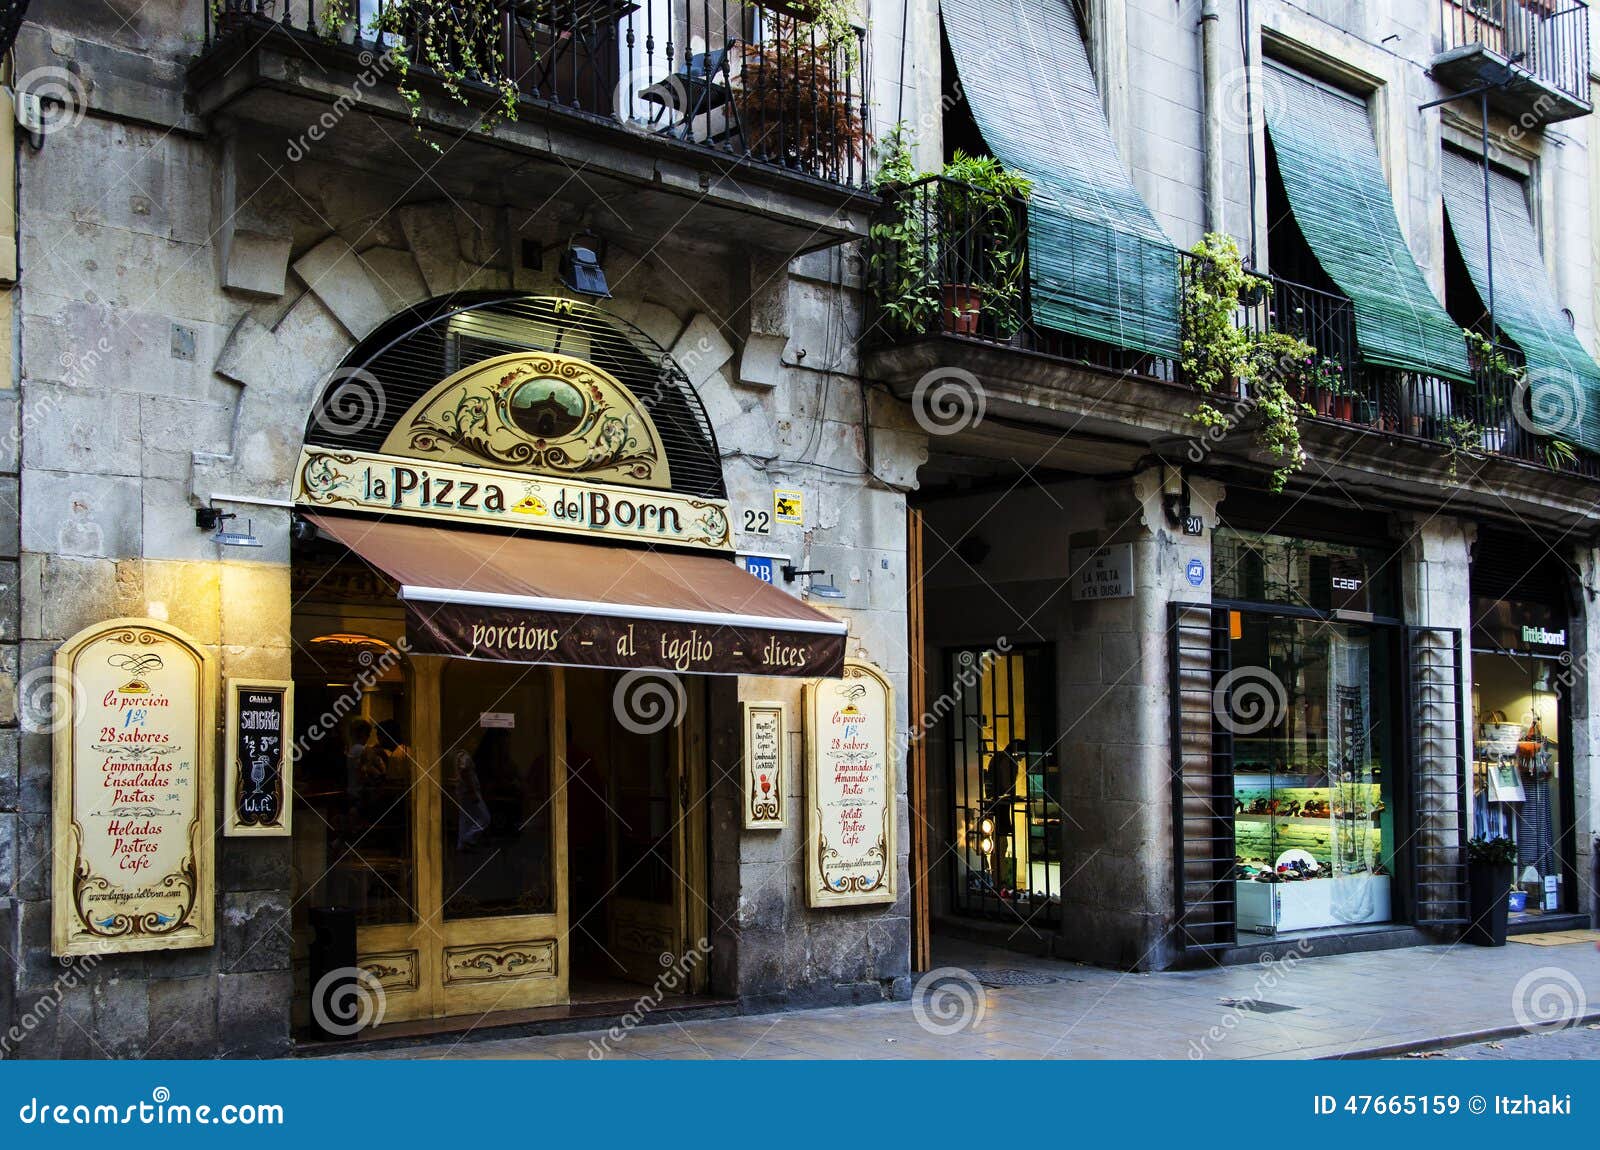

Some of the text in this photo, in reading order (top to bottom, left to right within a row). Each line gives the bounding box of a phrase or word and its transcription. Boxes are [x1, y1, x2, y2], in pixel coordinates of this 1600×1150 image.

[364, 466, 386, 500] la
[391, 466, 506, 513] Pizza
[552, 487, 584, 523] del
[744, 510, 769, 533] 22
[1187, 517, 1201, 533] 20
[467, 621, 559, 657] porcions
[616, 624, 637, 657] al
[660, 629, 713, 671] taglio
[762, 635, 806, 667] slices
[103, 690, 117, 707] la
[99, 727, 169, 743] 28 sabores
[831, 736, 869, 750] 28 sabors
[102, 756, 172, 775] Empanadas
[103, 772, 169, 788] Ensaladas
[112, 788, 155, 807] Pastas
